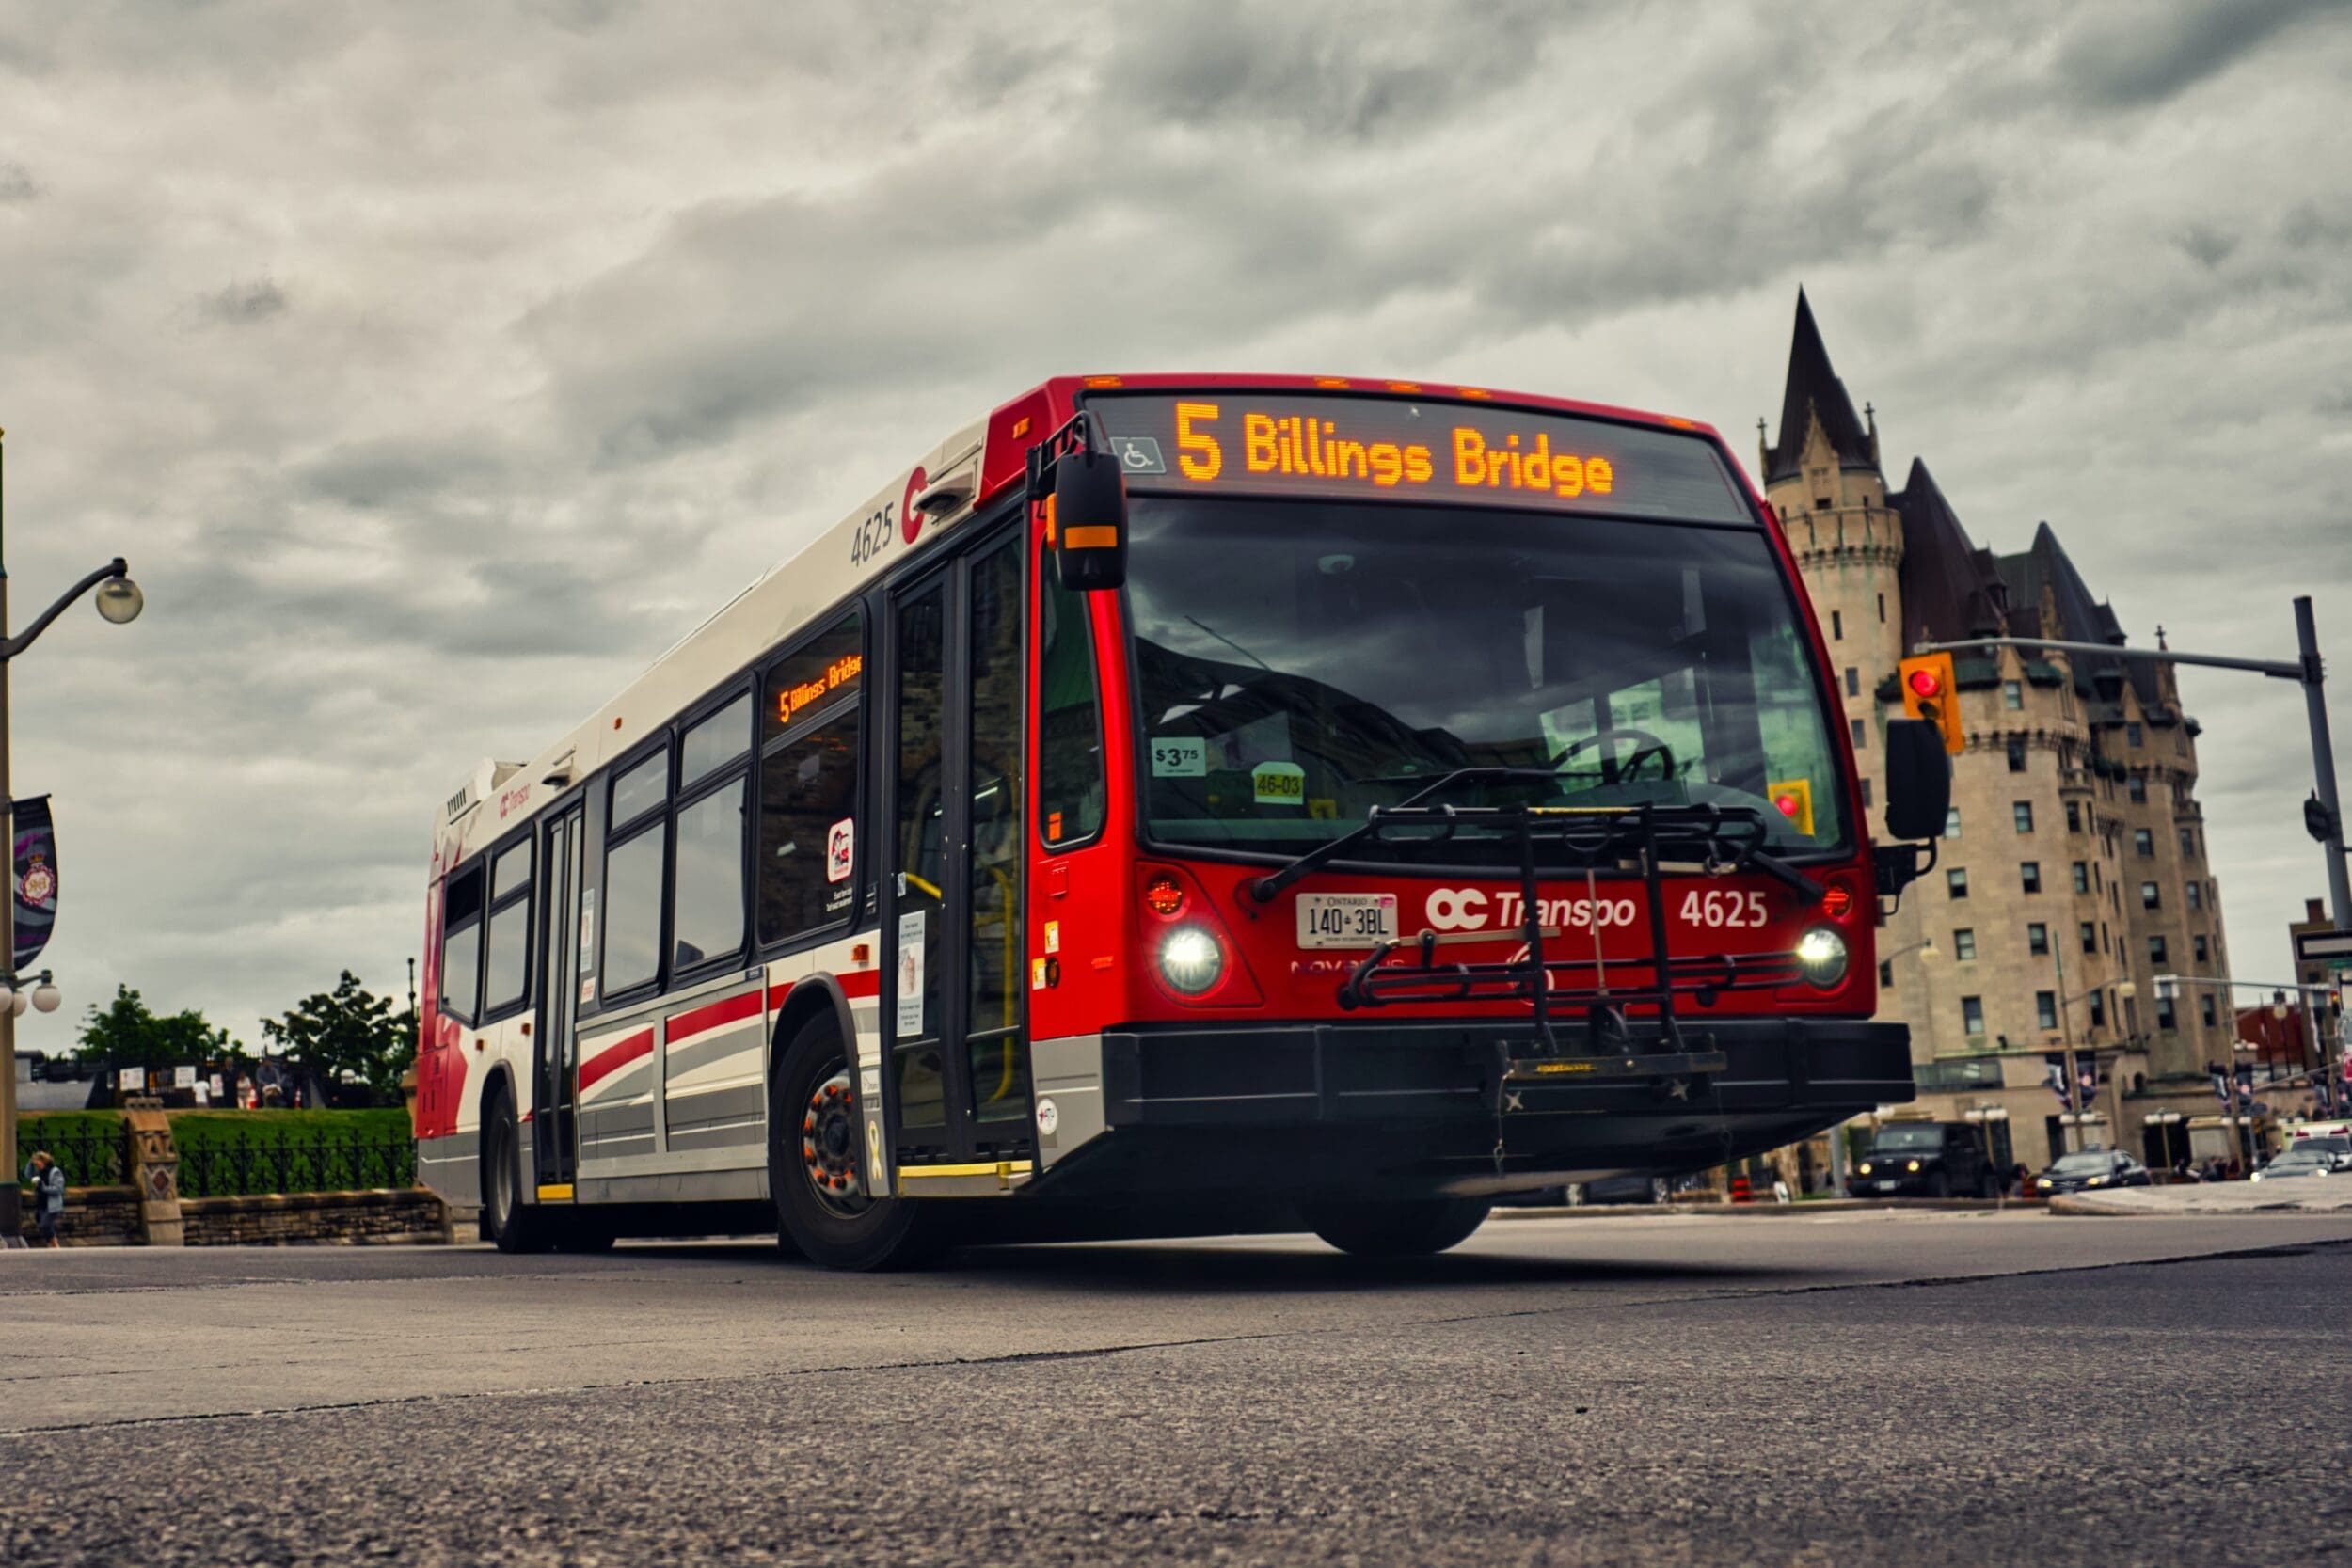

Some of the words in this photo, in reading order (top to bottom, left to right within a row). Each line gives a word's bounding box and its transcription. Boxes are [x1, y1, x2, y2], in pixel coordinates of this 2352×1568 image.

[1176, 402, 1222, 482] 5
[1245, 413, 1433, 487] Billings
[1453, 428, 1613, 498] Bridge
[850, 501, 895, 567] 4625
[779, 689, 790, 723] 5
[790, 677, 827, 712] Billings
[1257, 775, 1301, 795] 46-03
[1327, 896, 1369, 906] ONTARIO
[1425, 887, 1488, 930] OC
[1495, 892, 1636, 936] Transpo
[1680, 890, 1767, 927] 4625
